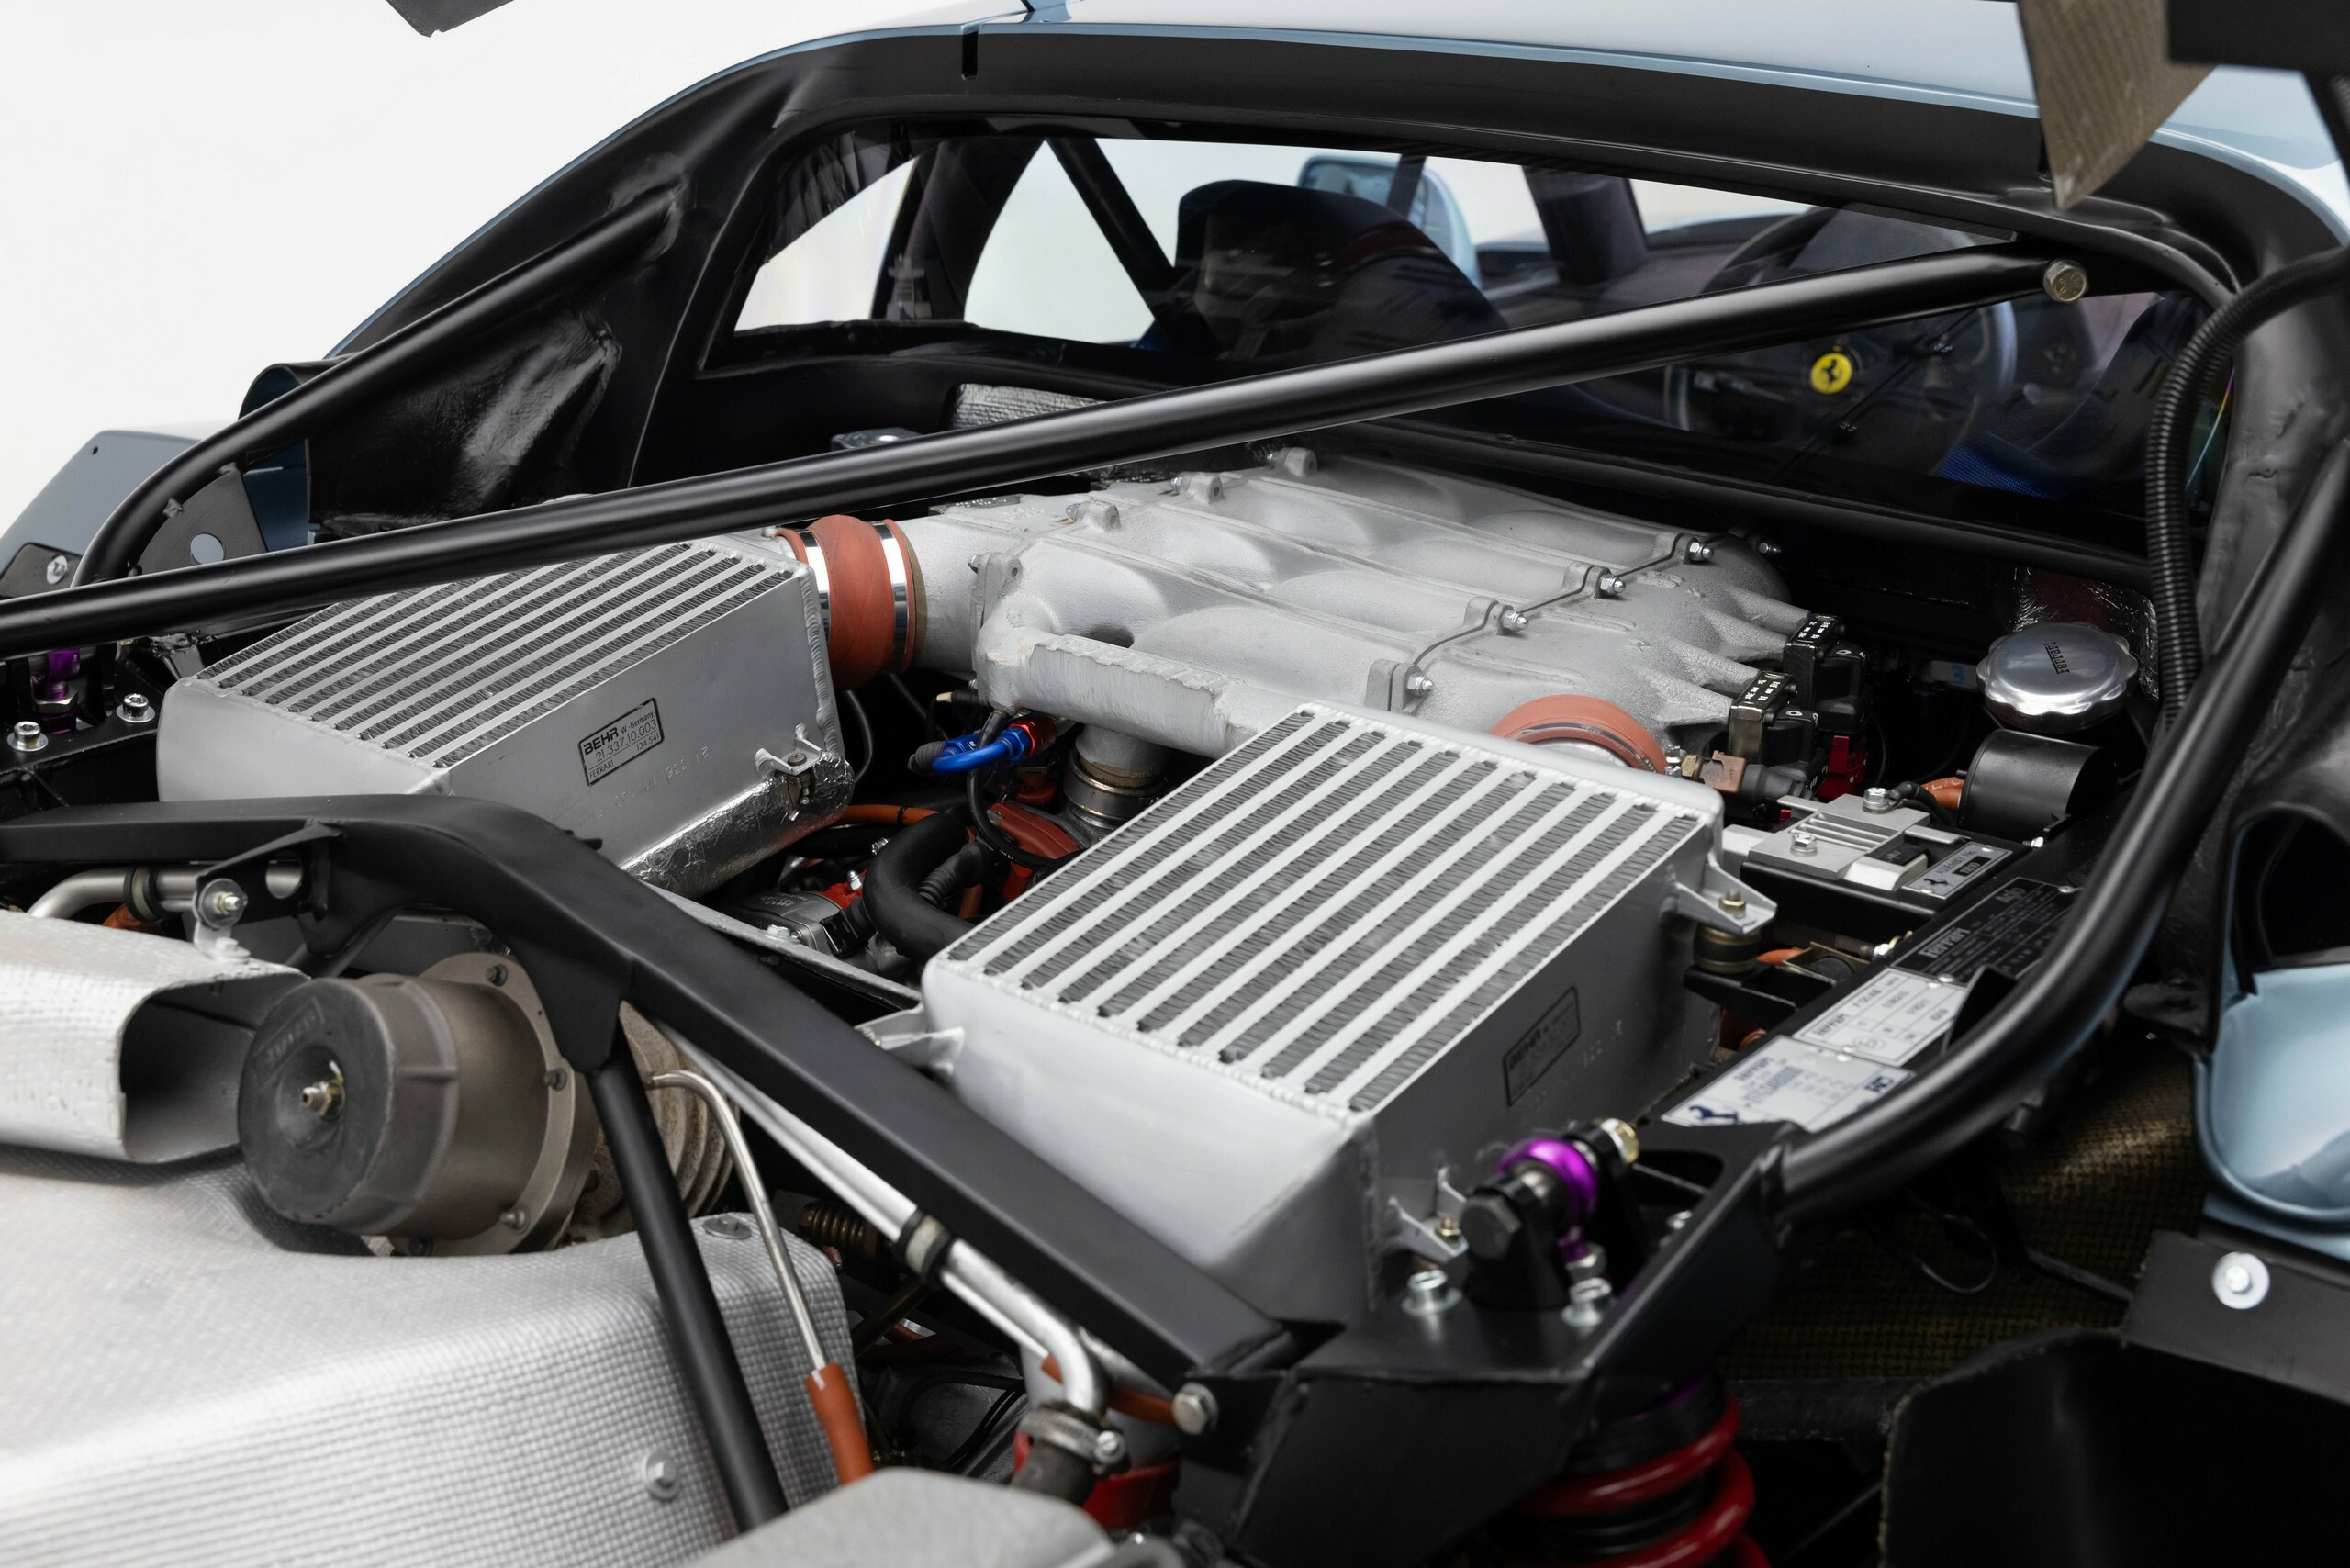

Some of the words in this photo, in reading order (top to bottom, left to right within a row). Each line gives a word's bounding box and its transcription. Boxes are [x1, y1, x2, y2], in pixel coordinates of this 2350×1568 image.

[2043, 641, 2070, 675] Ferrari
[584, 727, 619, 756] BEHR
[596, 719, 657, 763] 21.337.10.003
[589, 760, 614, 778] FERRARI
[1917, 926, 1972, 958] Ferrari
